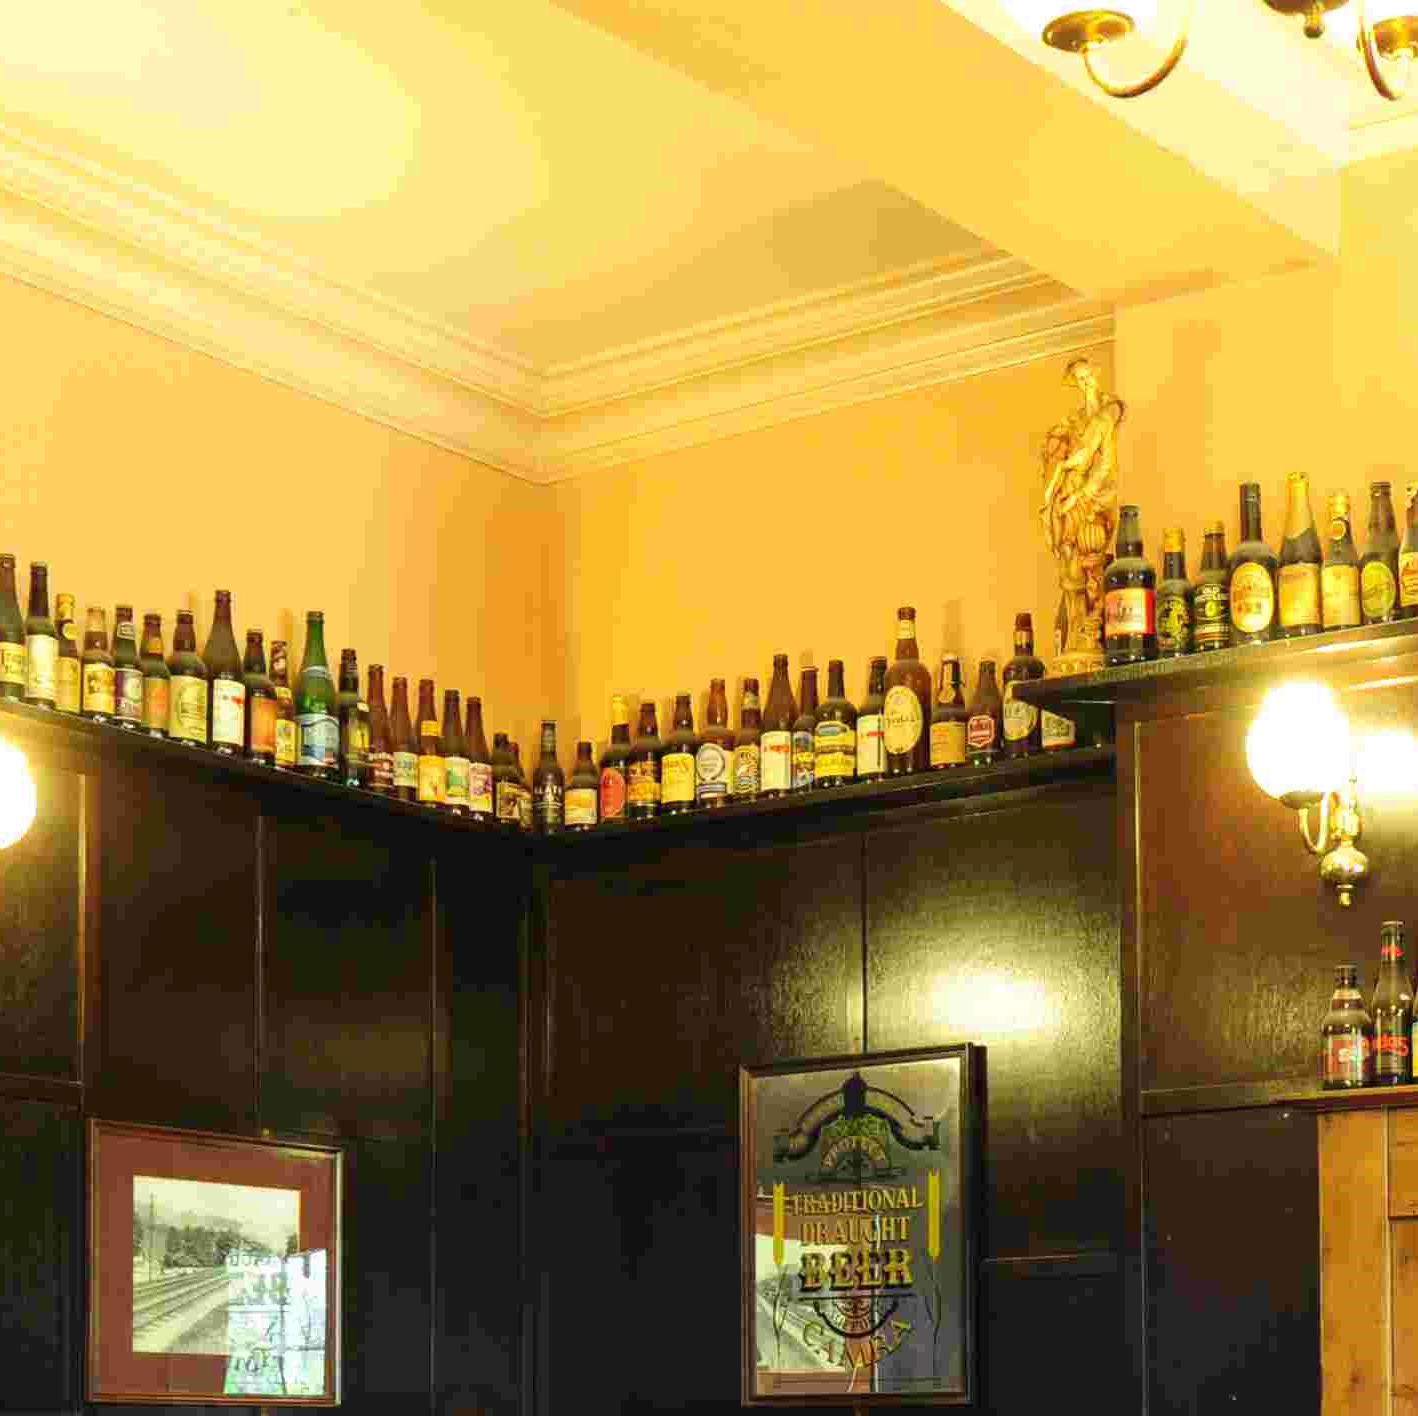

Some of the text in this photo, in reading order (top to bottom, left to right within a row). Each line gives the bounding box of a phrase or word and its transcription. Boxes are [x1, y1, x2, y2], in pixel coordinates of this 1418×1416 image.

[793, 1187, 923, 1216] TRADITIONAL
[800, 1216, 912, 1245] DRAUGHT
[798, 1247, 914, 1292] BEER
